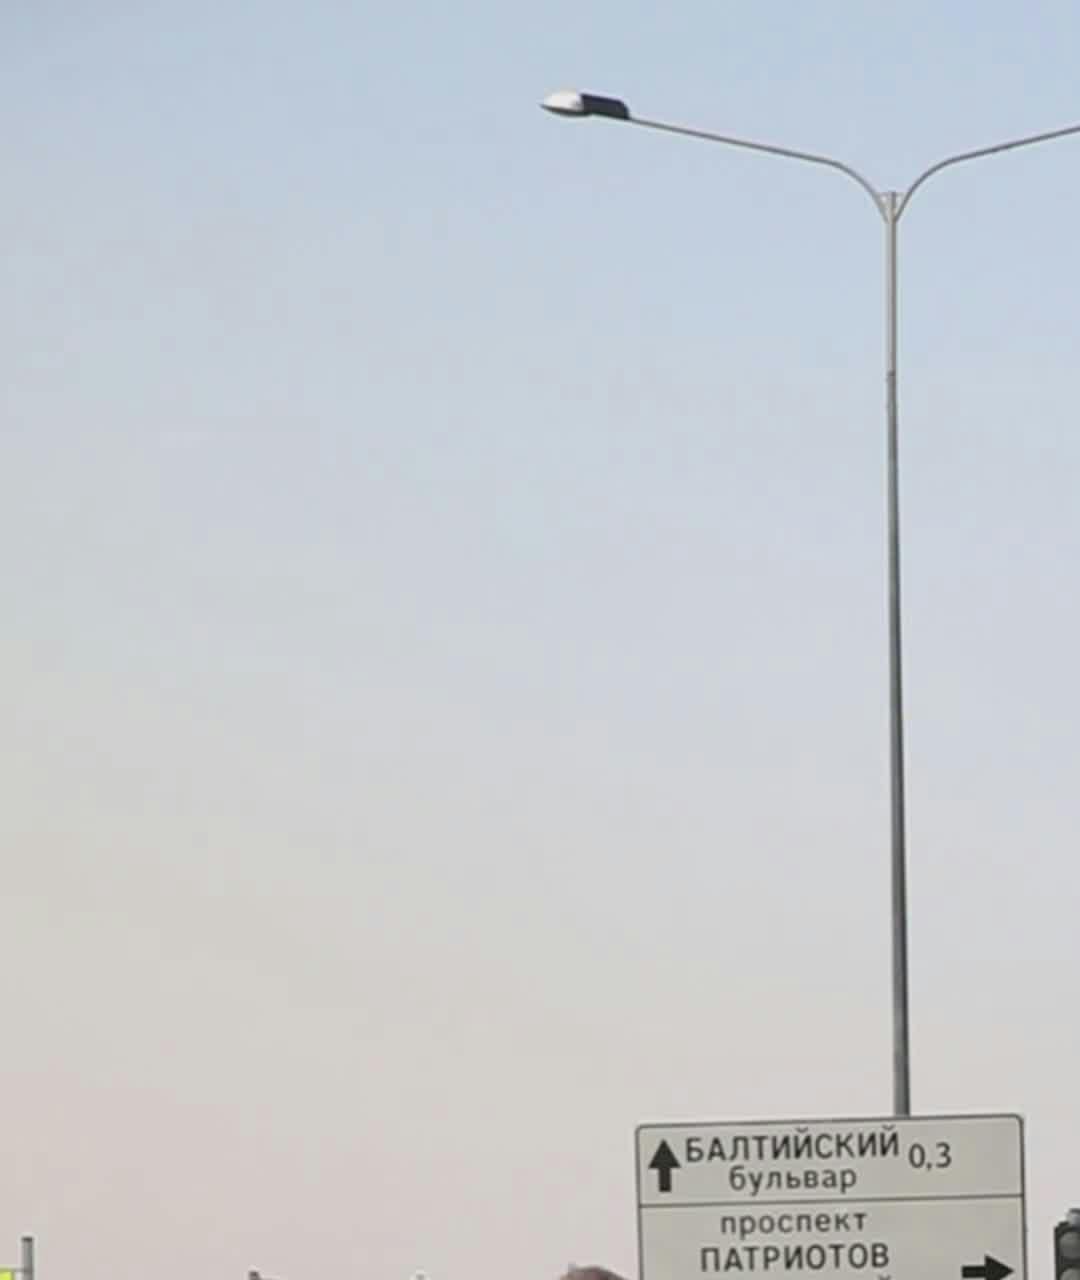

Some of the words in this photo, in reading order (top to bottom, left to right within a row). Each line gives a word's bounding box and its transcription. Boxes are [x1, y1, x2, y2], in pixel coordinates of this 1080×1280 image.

[685, 1124, 899, 1163] БАЛТИЙСКИЙ
[908, 1141, 952, 1171] 0,3
[728, 1165, 857, 1197] бульвар
[720, 1212, 868, 1239] проспект
[701, 1242, 889, 1272] ПАТРИОТОВ
